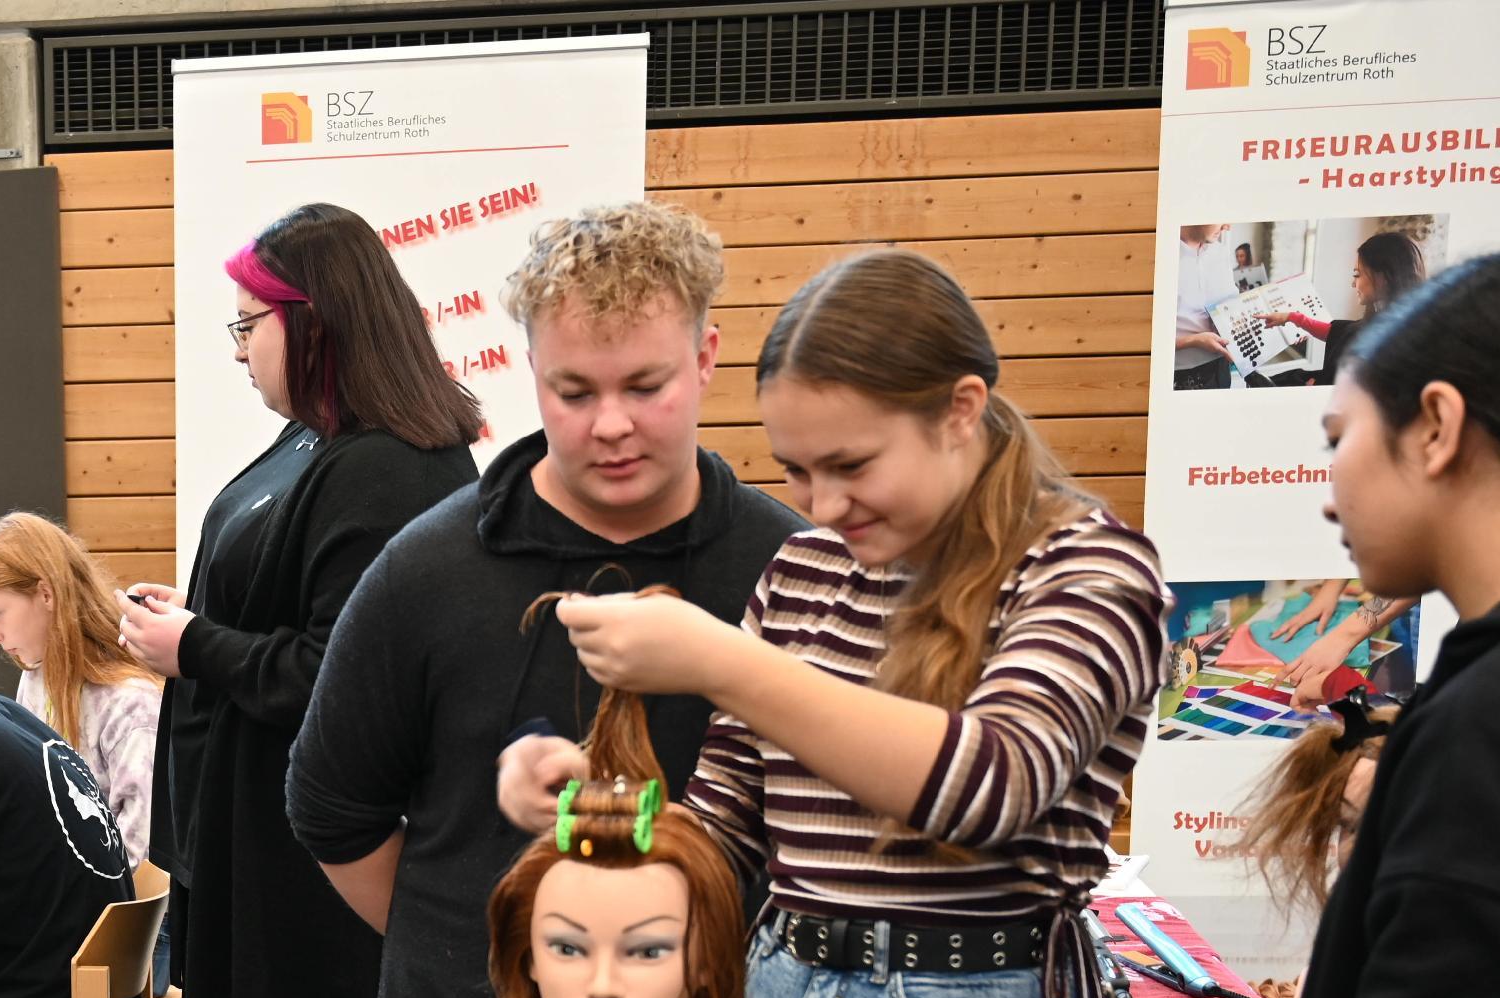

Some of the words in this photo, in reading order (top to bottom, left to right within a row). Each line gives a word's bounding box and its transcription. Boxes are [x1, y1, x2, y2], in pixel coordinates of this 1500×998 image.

[1268, 24, 1327, 56] BSZ
[1266, 57, 1338, 71] Staatliches
[1343, 52, 1417, 66] Berufliches
[1265, 71, 1358, 86] Schulzentrum
[1363, 67, 1394, 80] Roth
[327, 90, 374, 117] BSZ
[326, 118, 384, 130] Staatliches
[387, 115, 447, 127] Berufliches
[326, 130, 400, 143] Schulzentrum
[404, 127, 430, 138] Roth
[1321, 162, 1500, 189] Haarstyling
[376, 214, 435, 249] NEN
[439, 202, 473, 230] SIE
[479, 182, 538, 218] SEIN!
[1188, 464, 1333, 486] Färbetechni
